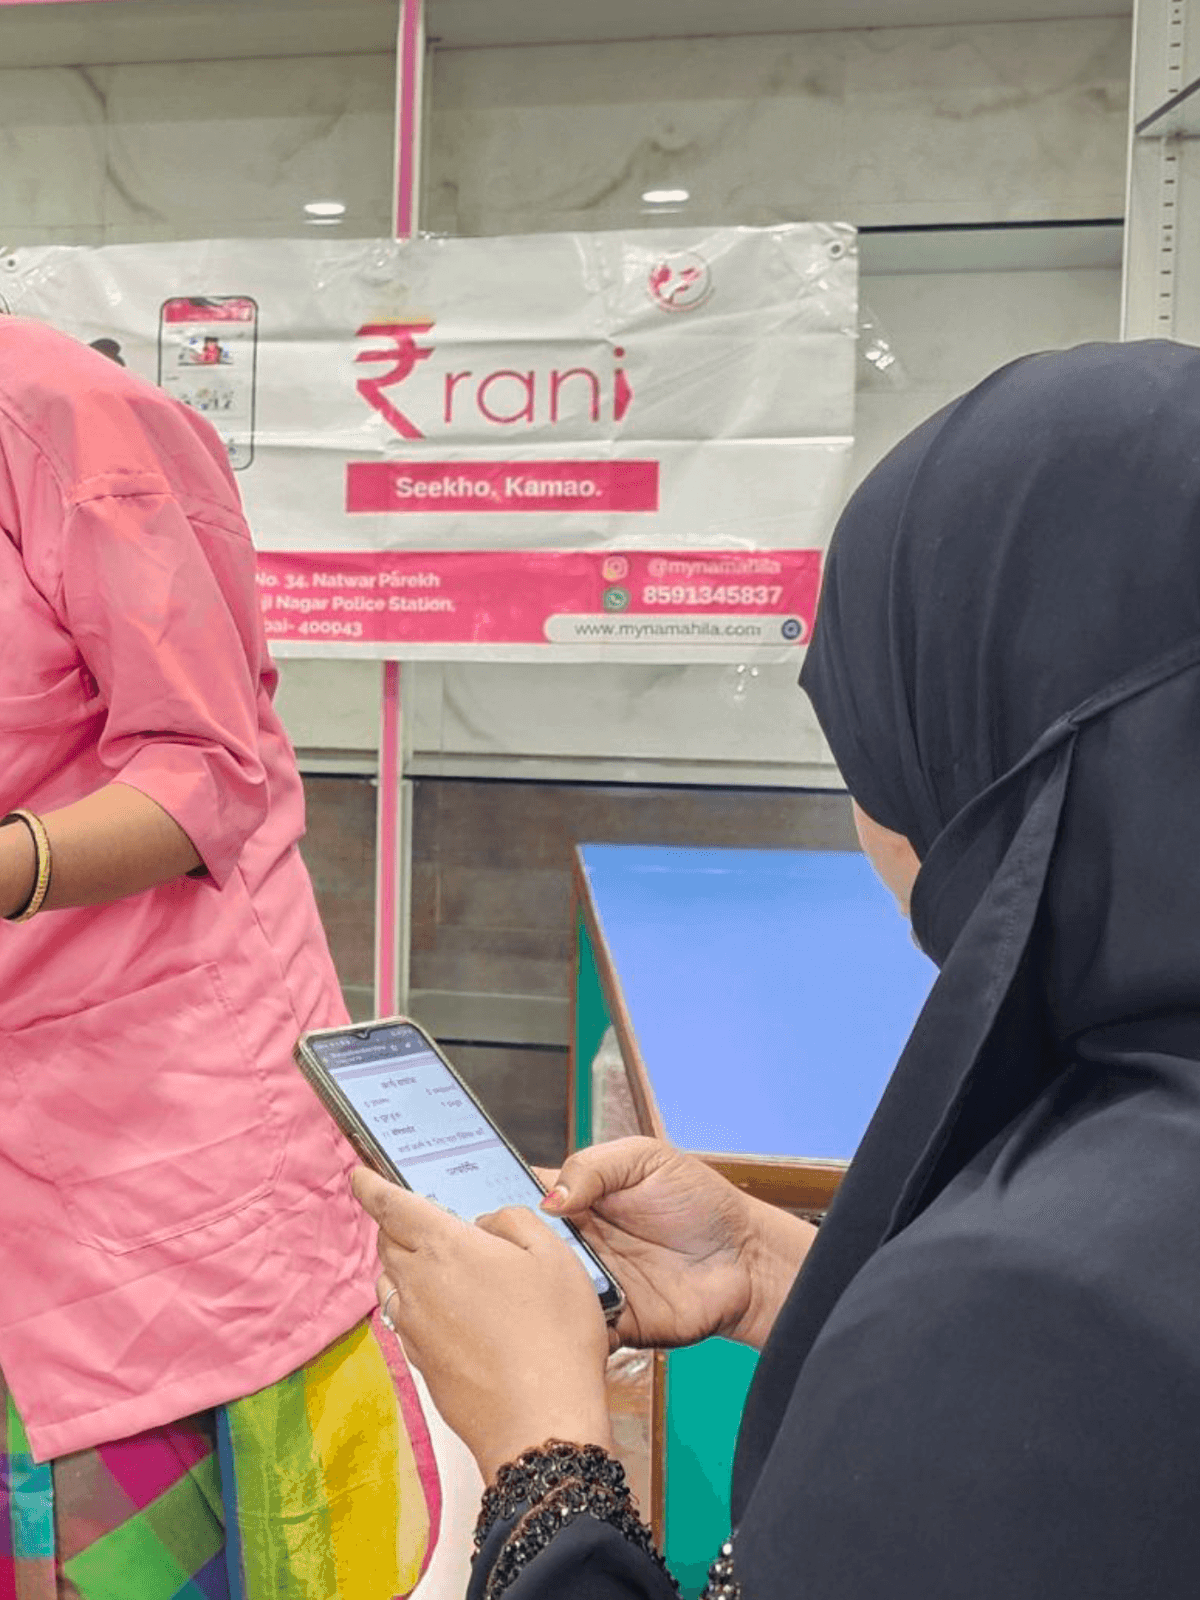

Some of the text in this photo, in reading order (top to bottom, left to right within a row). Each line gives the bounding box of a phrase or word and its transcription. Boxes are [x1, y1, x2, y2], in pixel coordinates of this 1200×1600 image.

[444, 346, 634, 424] rani
[504, 476, 603, 498] Kamao.
[312, 572, 376, 588] Natwar
[378, 571, 441, 588] Parekh
[275, 594, 329, 614] Nagar
[332, 595, 386, 613] Police
[643, 585, 783, 605] 8591345837
[297, 619, 363, 638] 400043
[574, 621, 762, 638] www.mynamahila.com
